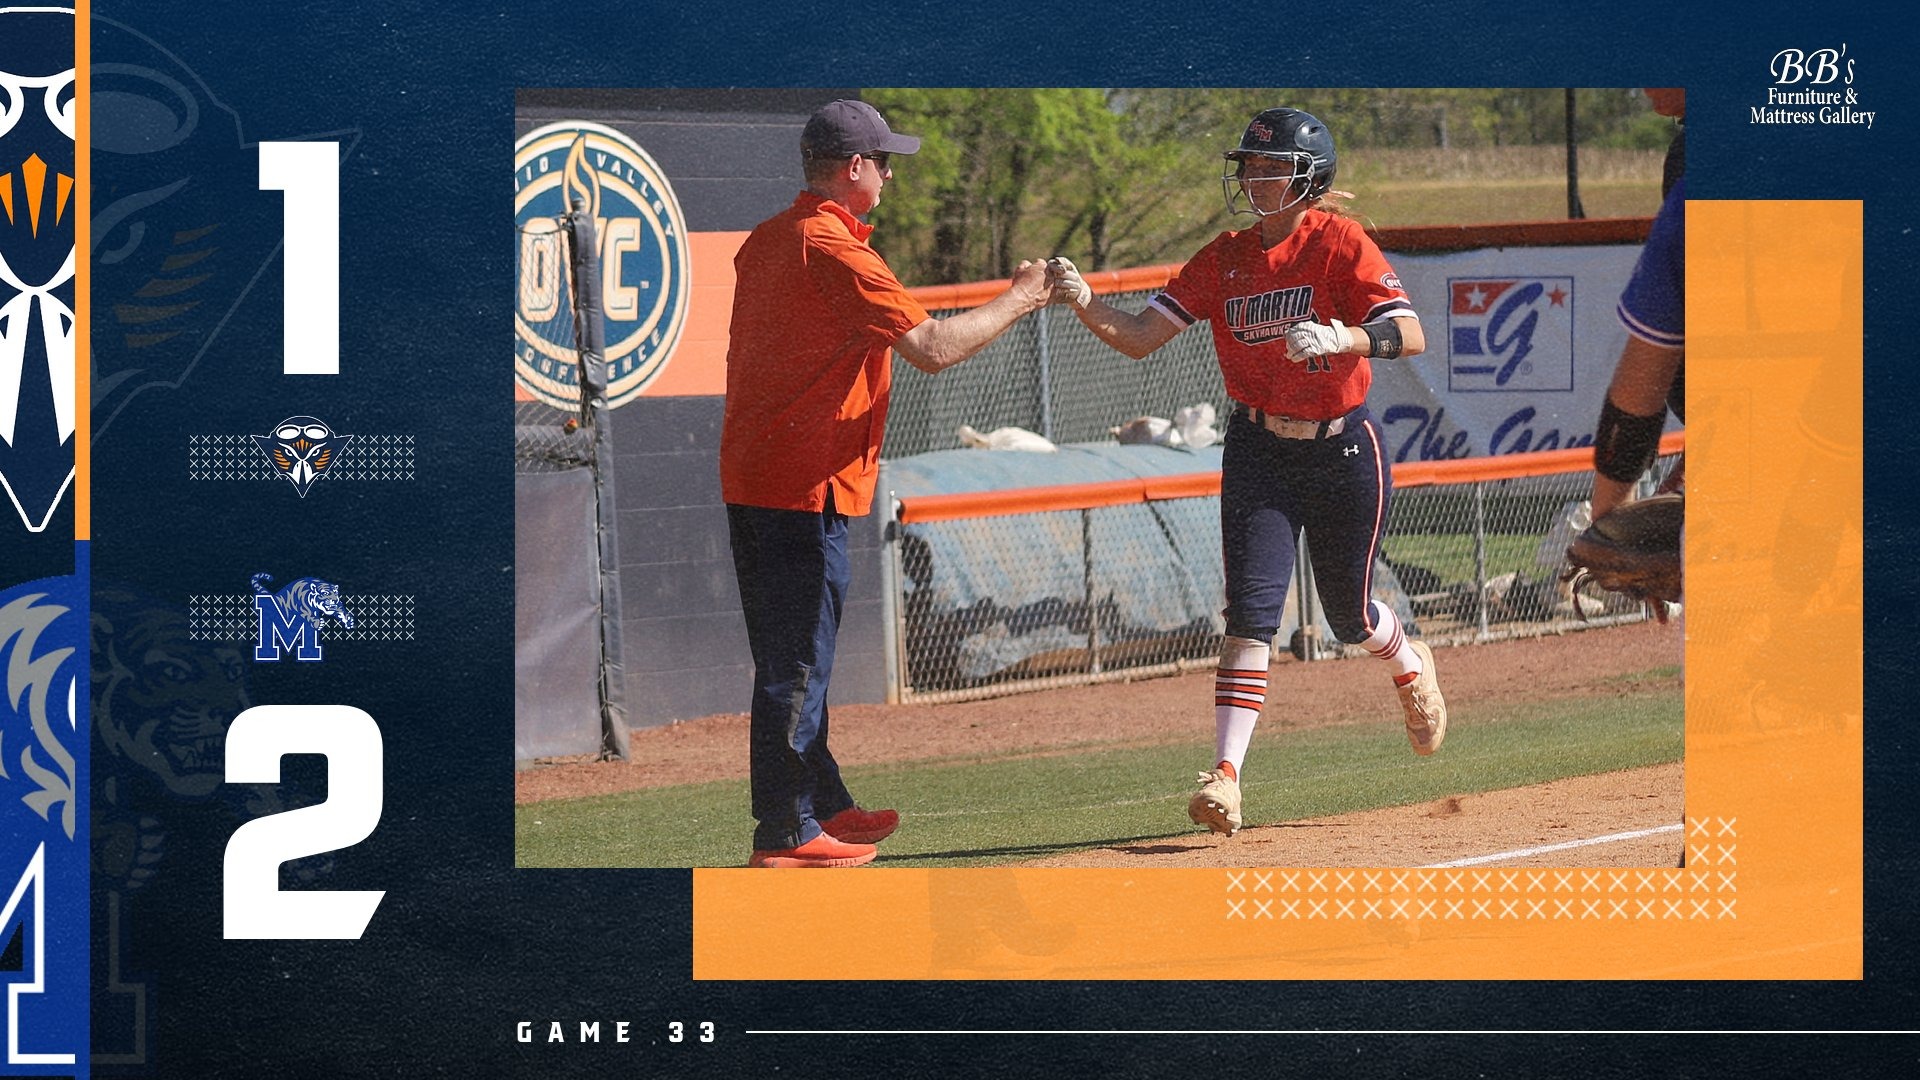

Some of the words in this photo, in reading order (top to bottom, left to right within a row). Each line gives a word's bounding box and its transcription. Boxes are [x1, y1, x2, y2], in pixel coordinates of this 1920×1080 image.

[596, 153, 674, 238] VALLEY
[1225, 298, 1244, 328] UT
[1244, 285, 1313, 327] MARTIN
[1243, 322, 1292, 341] SKYHAWKS
[1382, 404, 1471, 462] The
